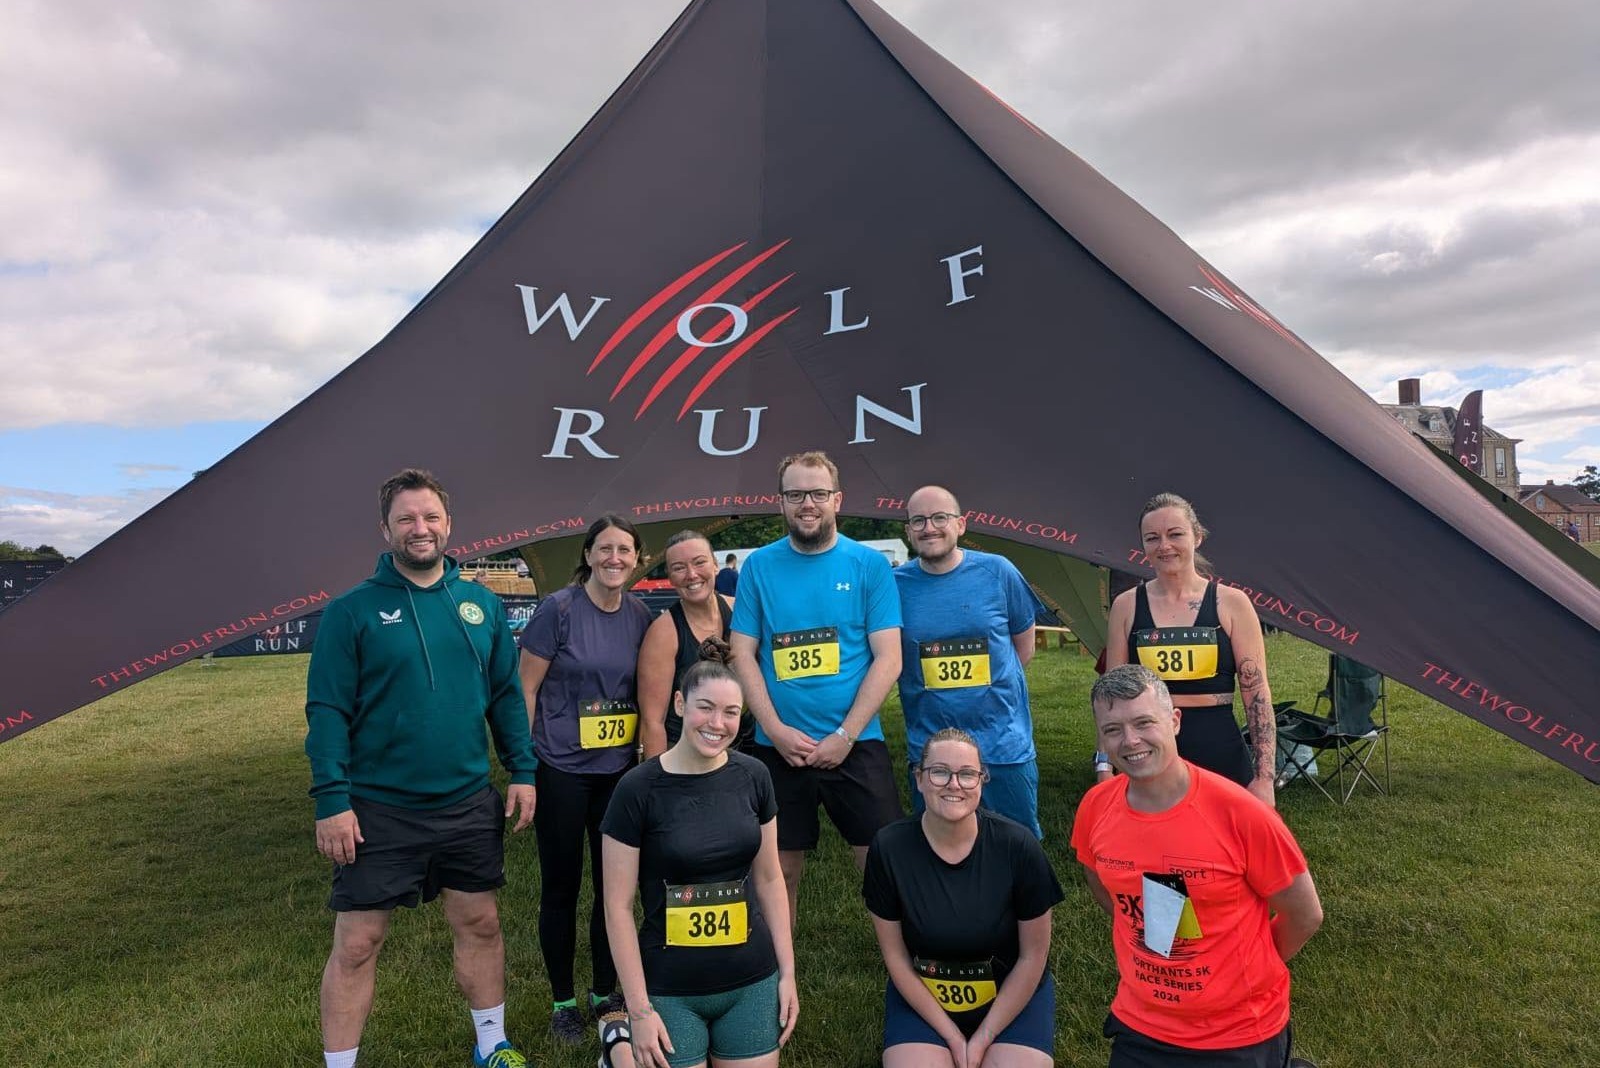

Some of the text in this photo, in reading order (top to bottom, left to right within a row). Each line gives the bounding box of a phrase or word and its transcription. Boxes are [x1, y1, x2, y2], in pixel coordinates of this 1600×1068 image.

[514, 245, 984, 347] WOLF
[541, 382, 928, 459] RUN
[91, 589, 331, 689] THEWOLFRUN.COM
[810, 632, 832, 640] RUN
[1143, 631, 1209, 641] WOLF RUN
[255, 637, 300, 652] RUN
[925, 644, 954, 652] WOLF
[788, 648, 822, 672] 385
[1156, 649, 1194, 673] 381
[938, 659, 973, 682] 382
[585, 703, 613, 712] WOLF
[597, 719, 626, 741] 378
[674, 887, 740, 900] WOLF RUN
[688, 909, 731, 938] 384
[920, 964, 951, 975] WOLF
[1195, 965, 1211, 977] 5K
[1164, 978, 1203, 992] SERIES
[936, 984, 977, 1005] 380
[1152, 989, 1181, 1003] 2024
